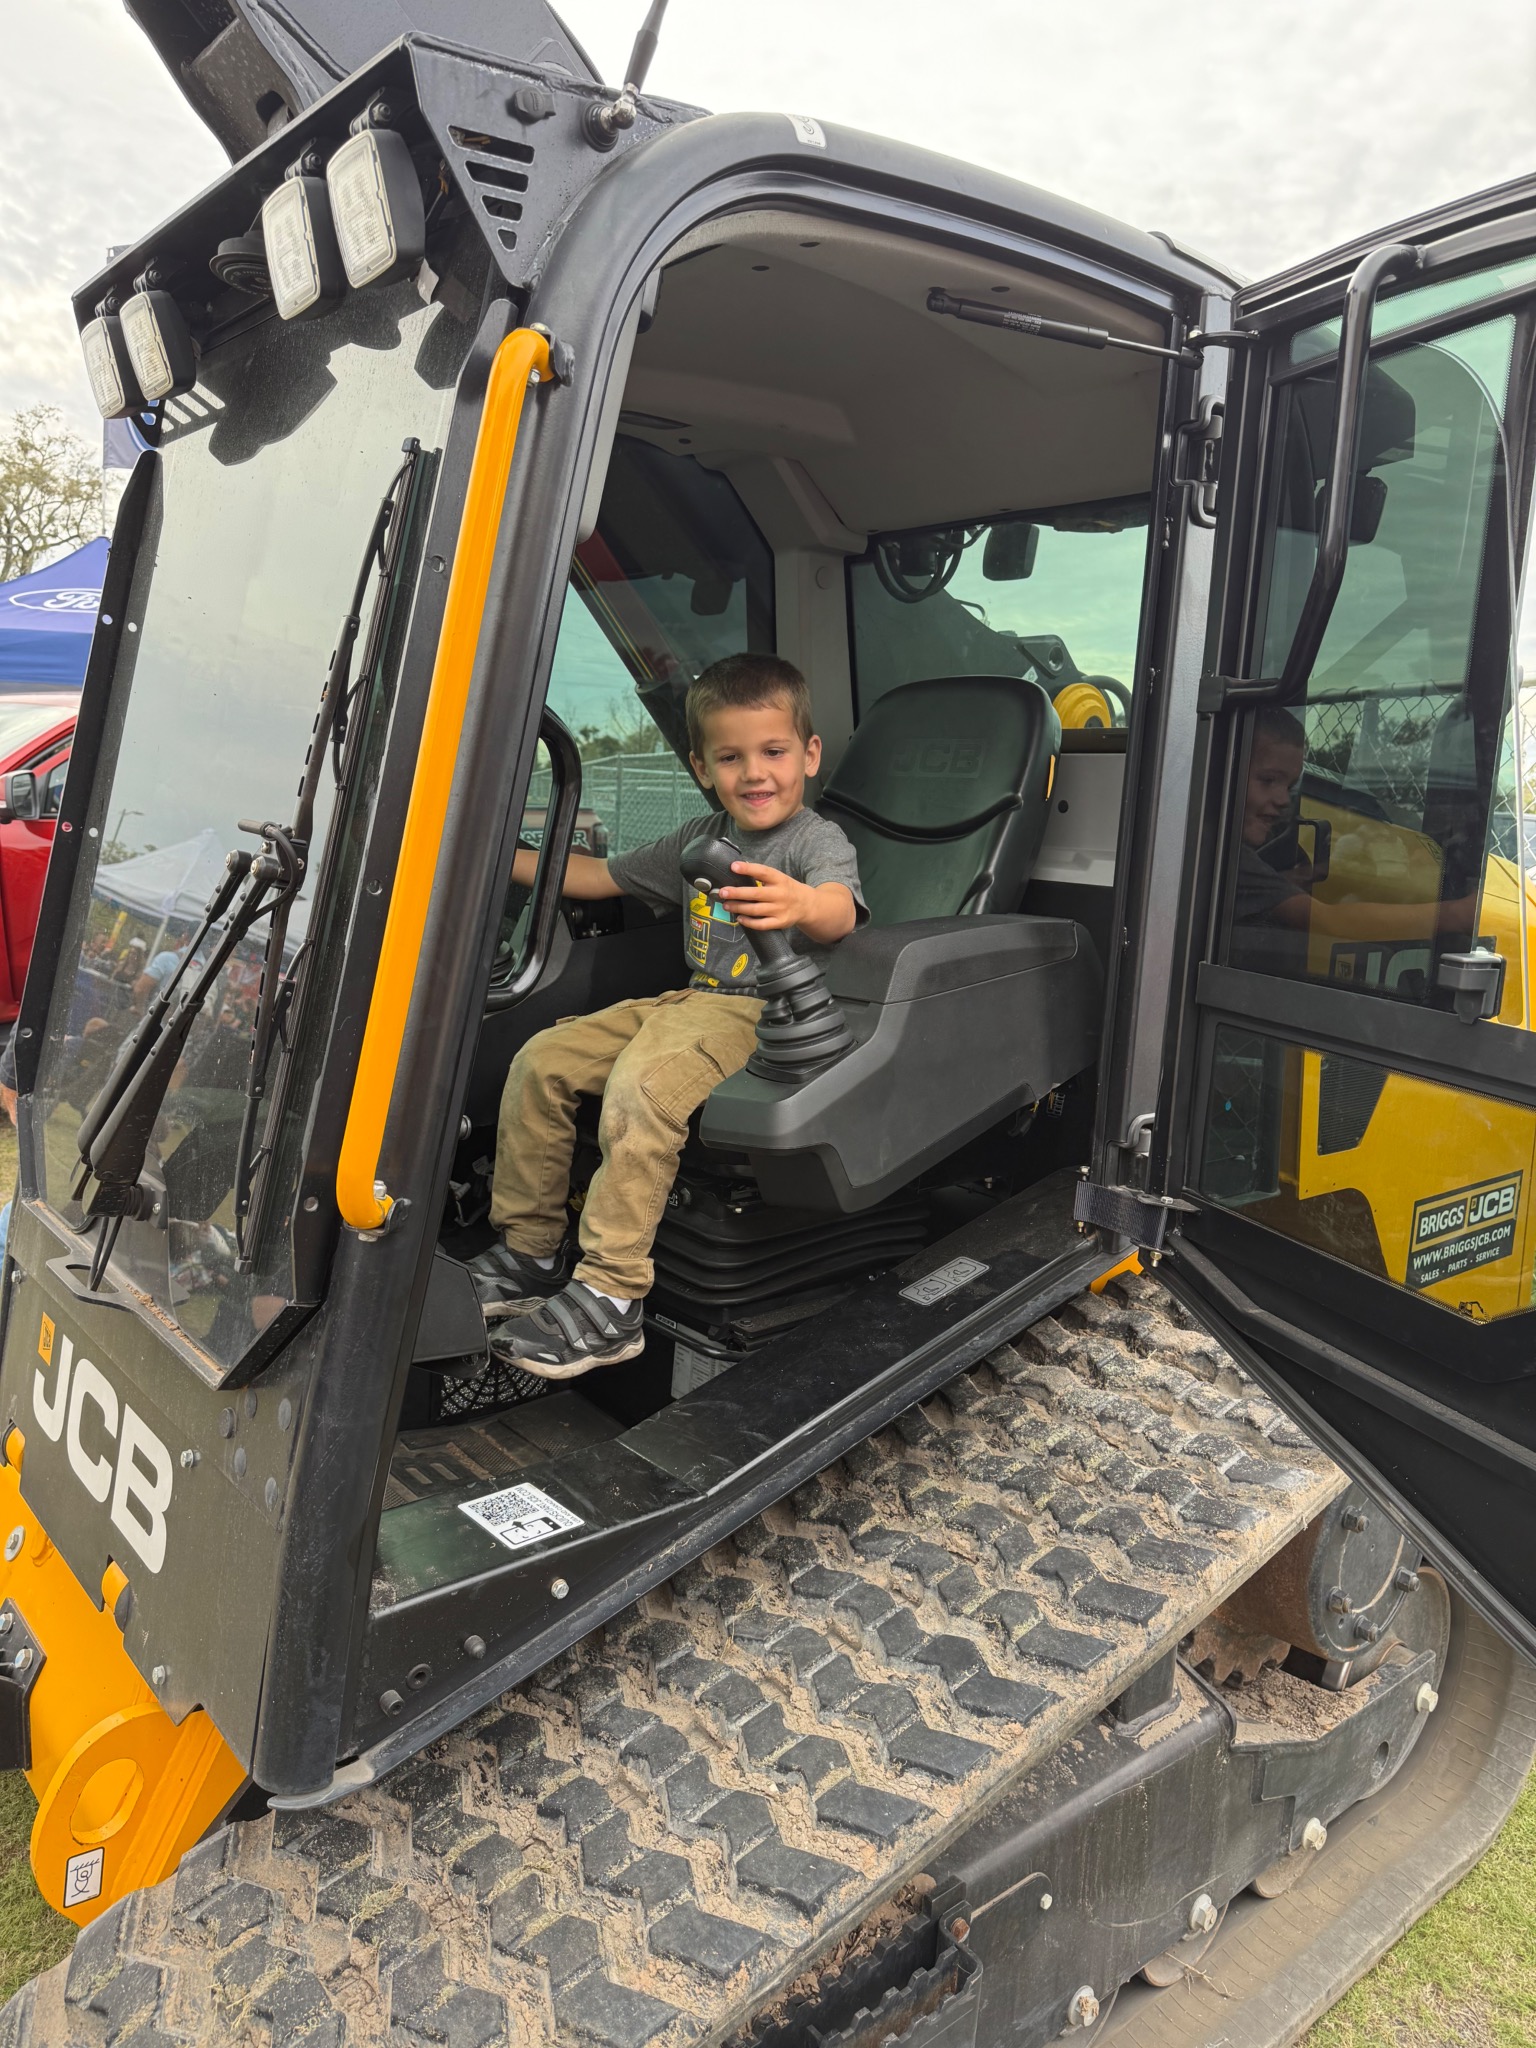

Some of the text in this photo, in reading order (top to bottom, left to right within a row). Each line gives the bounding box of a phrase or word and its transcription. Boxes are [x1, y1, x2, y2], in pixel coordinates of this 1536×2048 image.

[43, 591, 102, 610] Fo
[892, 741, 982, 774] JCB
[1419, 1186, 1515, 1238] BRIGGS JCB
[1413, 1225, 1511, 1270] WWW.BRIGGSJCB.COM
[1420, 1247, 1500, 1283] SALES PARTS SERVICE
[33, 1334, 173, 1574] JCB
